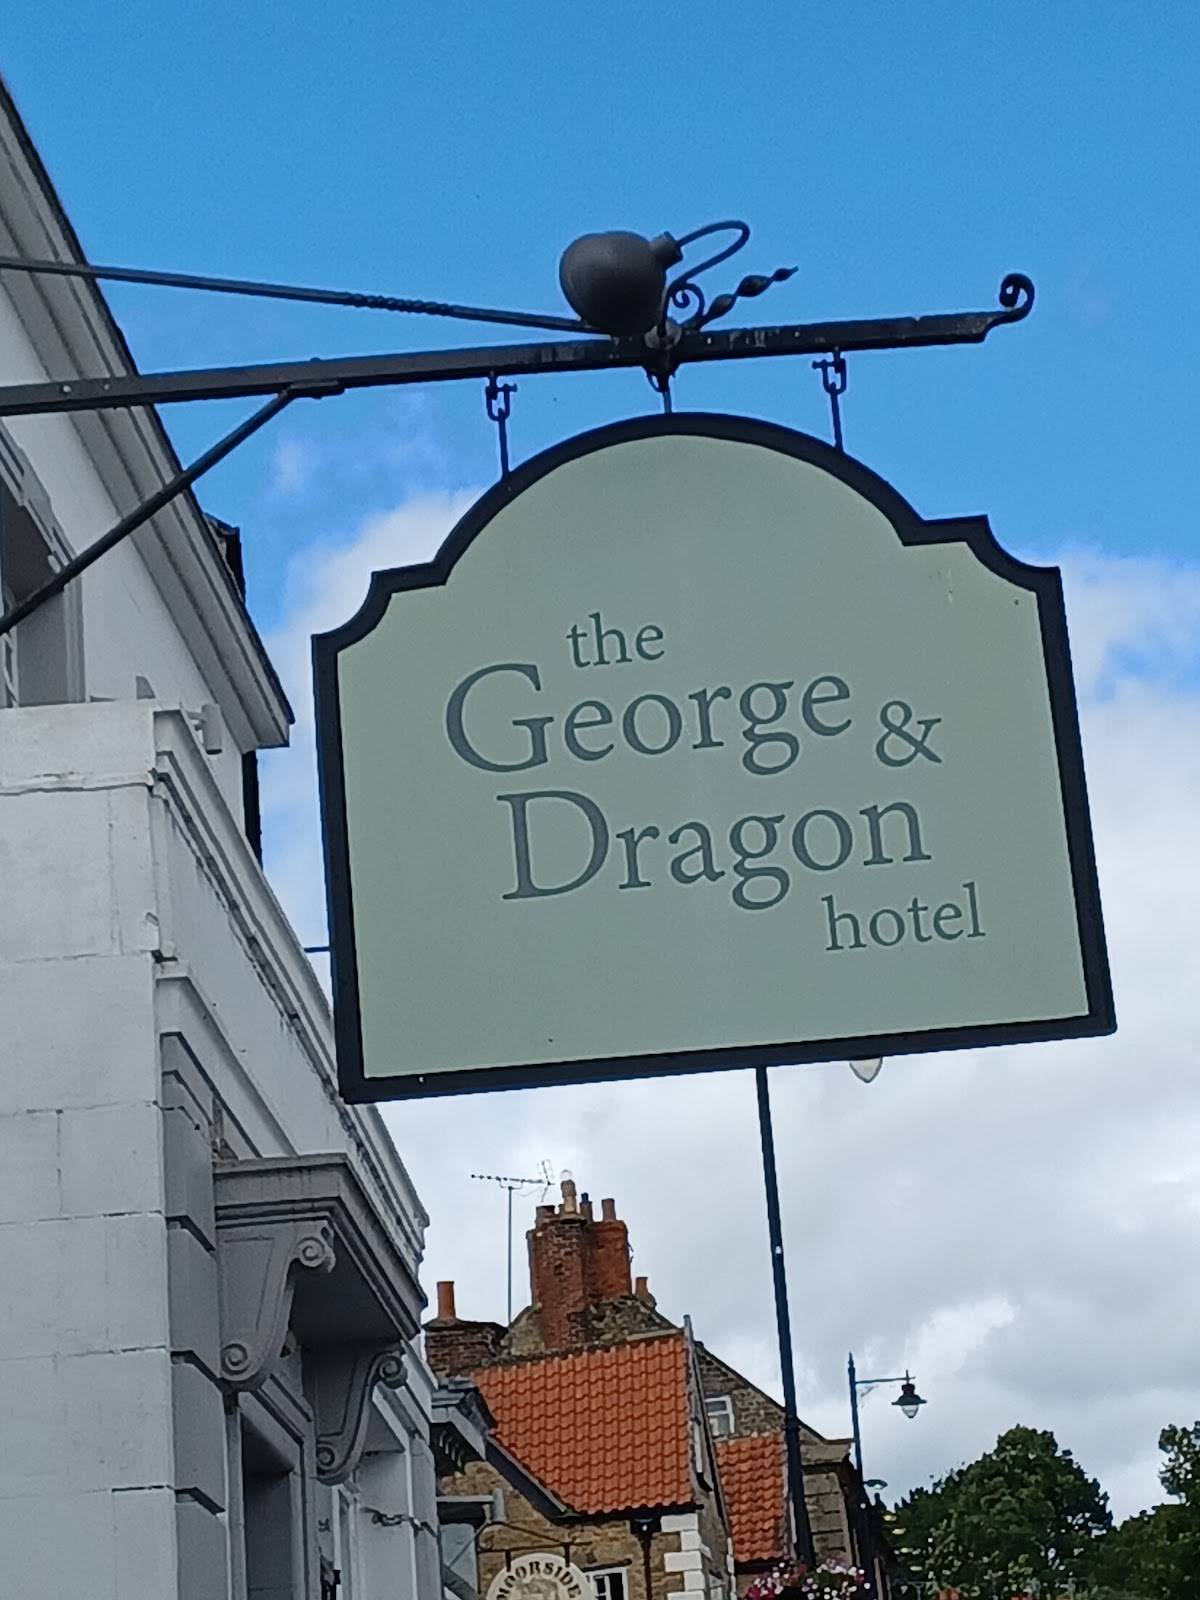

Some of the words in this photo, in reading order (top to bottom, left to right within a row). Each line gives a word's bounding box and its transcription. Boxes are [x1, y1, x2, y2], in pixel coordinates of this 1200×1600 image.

[565, 611, 665, 669] the
[445, 662, 853, 776] George
[875, 700, 943, 768] &
[495, 789, 933, 911] Dragon
[820, 880, 987, 952] hotel
